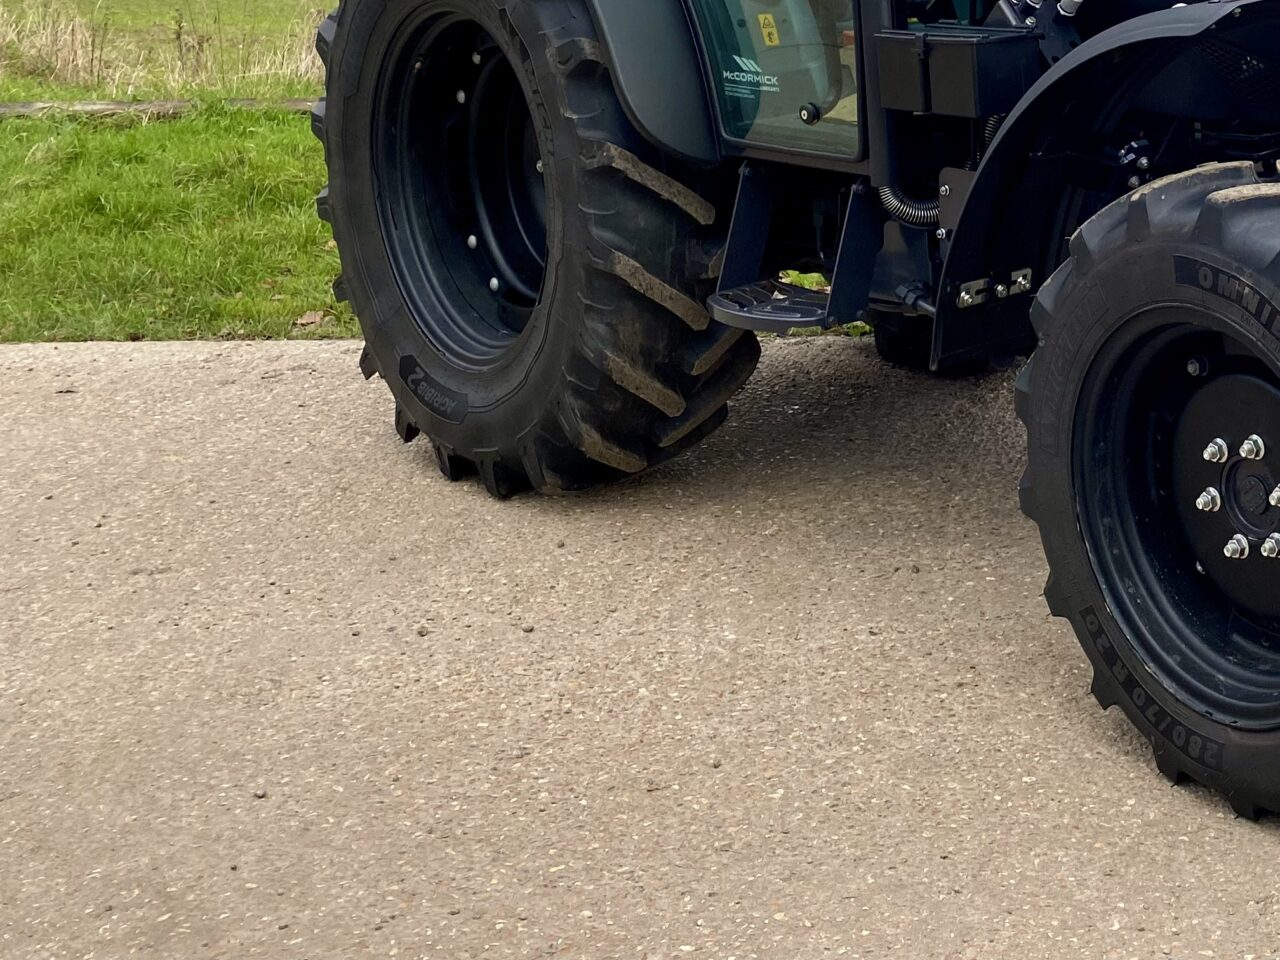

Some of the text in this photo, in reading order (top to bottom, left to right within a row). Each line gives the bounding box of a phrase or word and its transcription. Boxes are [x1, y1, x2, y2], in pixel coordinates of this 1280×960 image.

[723, 70, 778, 85] McCORMICK
[407, 366, 458, 414] AGRIBIB 2
